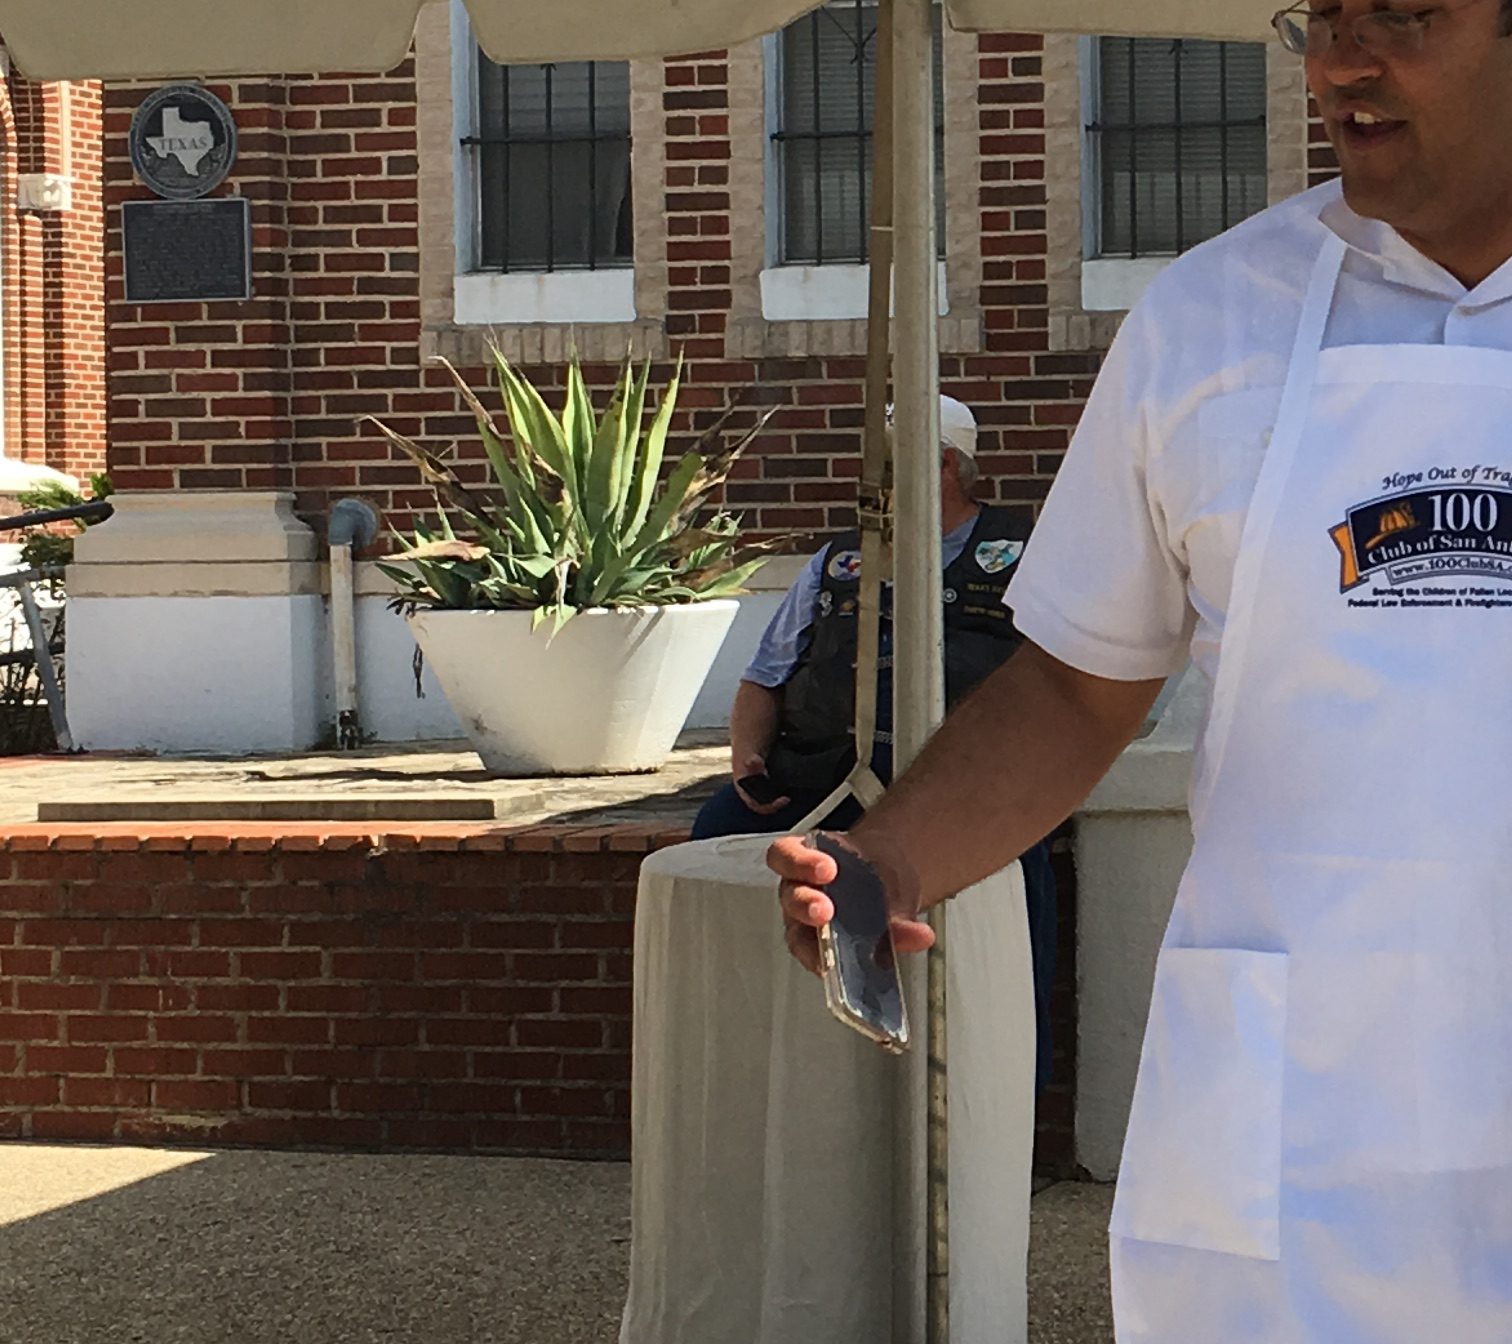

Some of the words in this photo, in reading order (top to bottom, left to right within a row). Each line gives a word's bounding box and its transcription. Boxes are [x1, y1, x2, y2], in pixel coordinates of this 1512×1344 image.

[158, 135, 208, 152] TEXAS
[1381, 470, 1423, 491] Hope
[1428, 466, 1457, 480] Out
[1461, 463, 1481, 484] of
[1428, 492, 1498, 532] 100
[1367, 538, 1413, 565] Club
[1416, 532, 1437, 552] of
[1439, 533, 1477, 549] San
